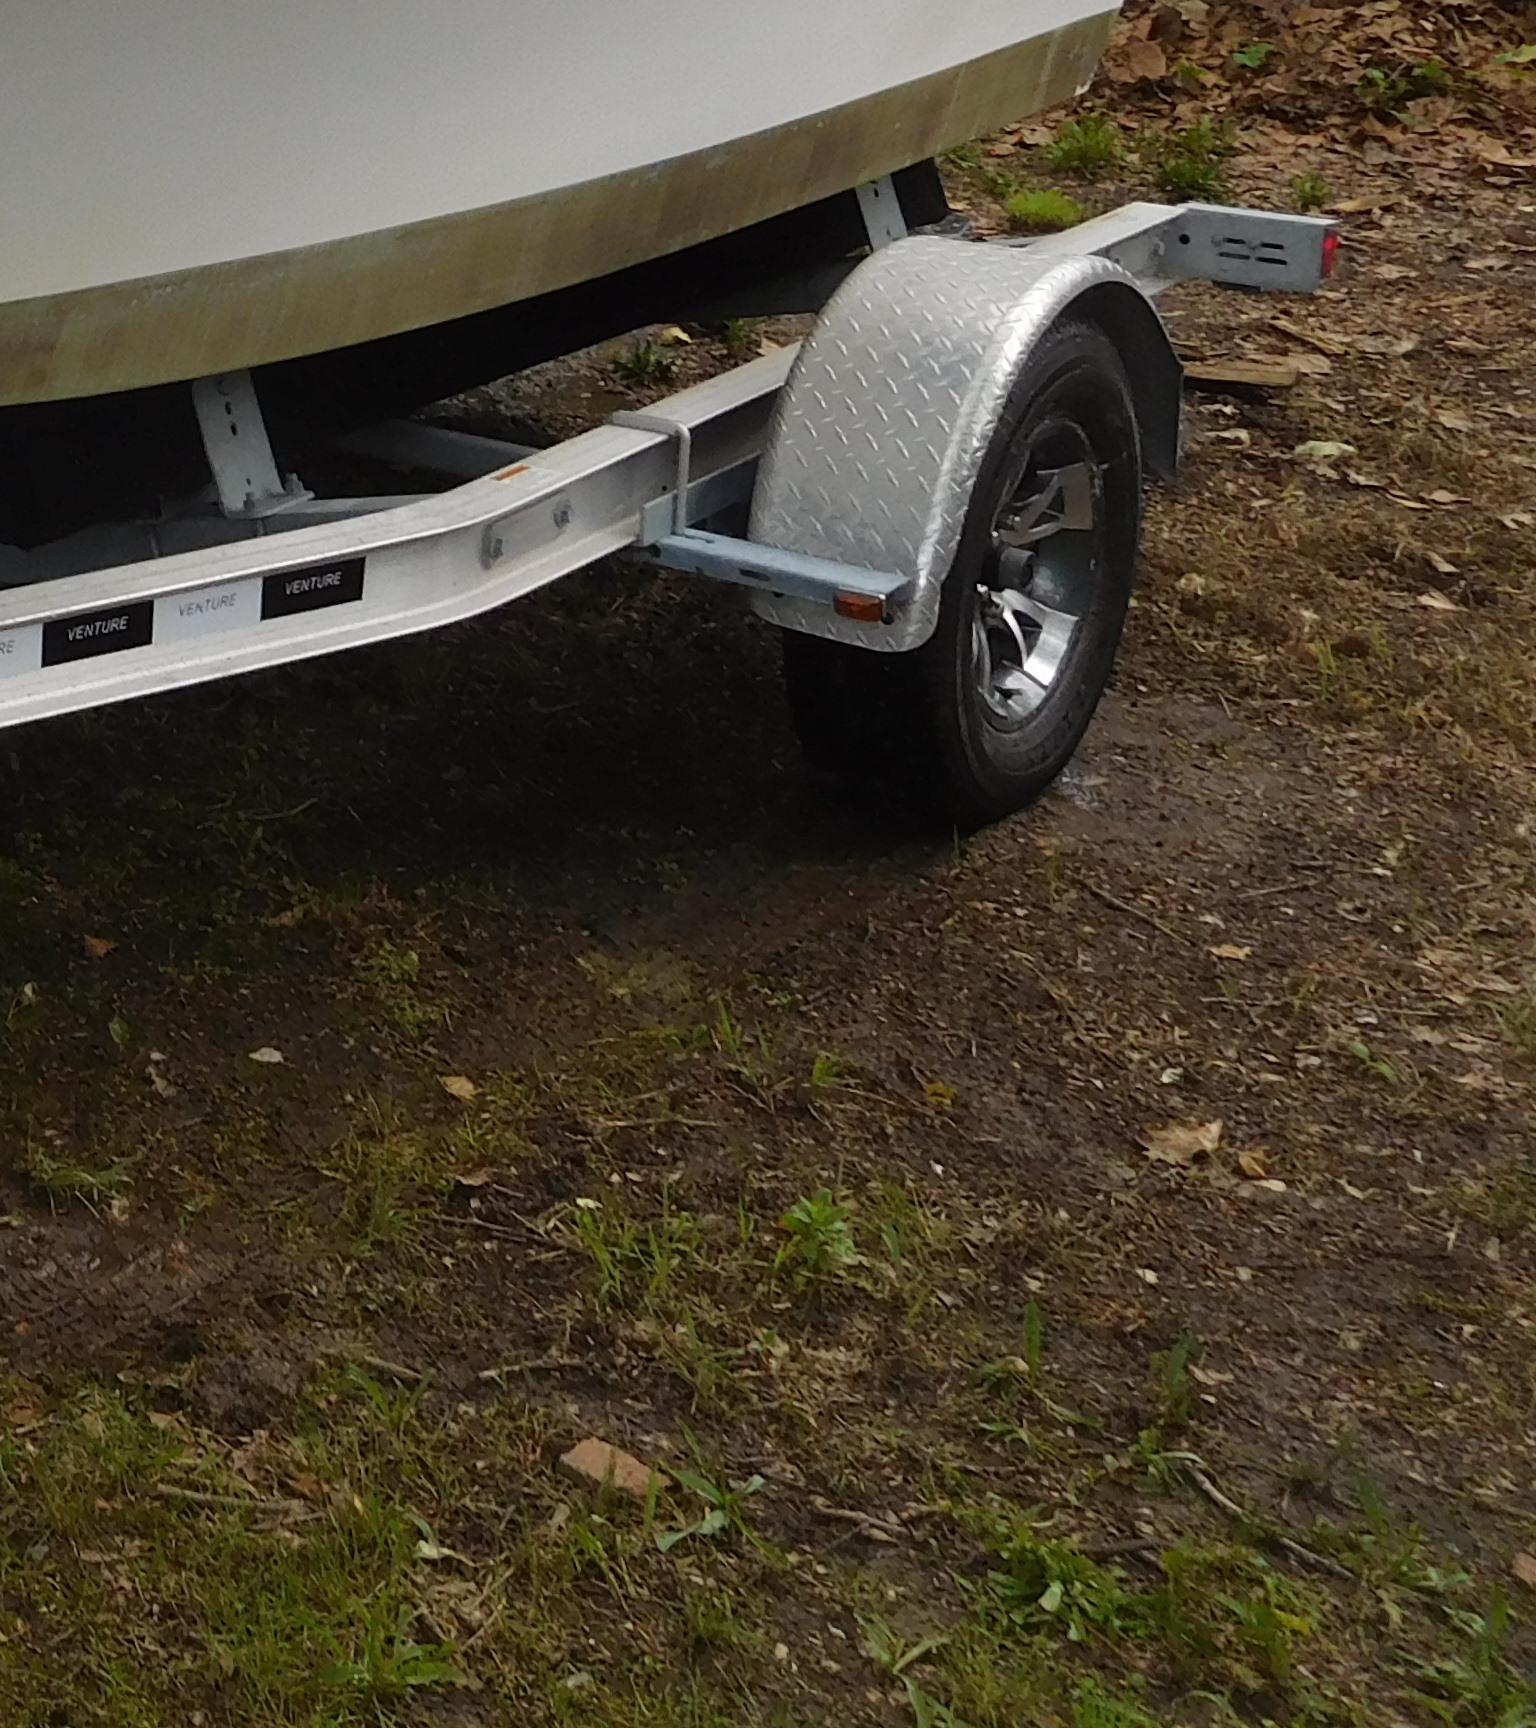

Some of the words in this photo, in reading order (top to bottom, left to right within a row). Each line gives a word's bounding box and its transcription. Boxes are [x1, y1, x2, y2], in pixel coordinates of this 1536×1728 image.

[285, 571, 342, 595] VENTURE
[178, 594, 237, 618] VENTURE
[67, 615, 128, 641] VENTURE
